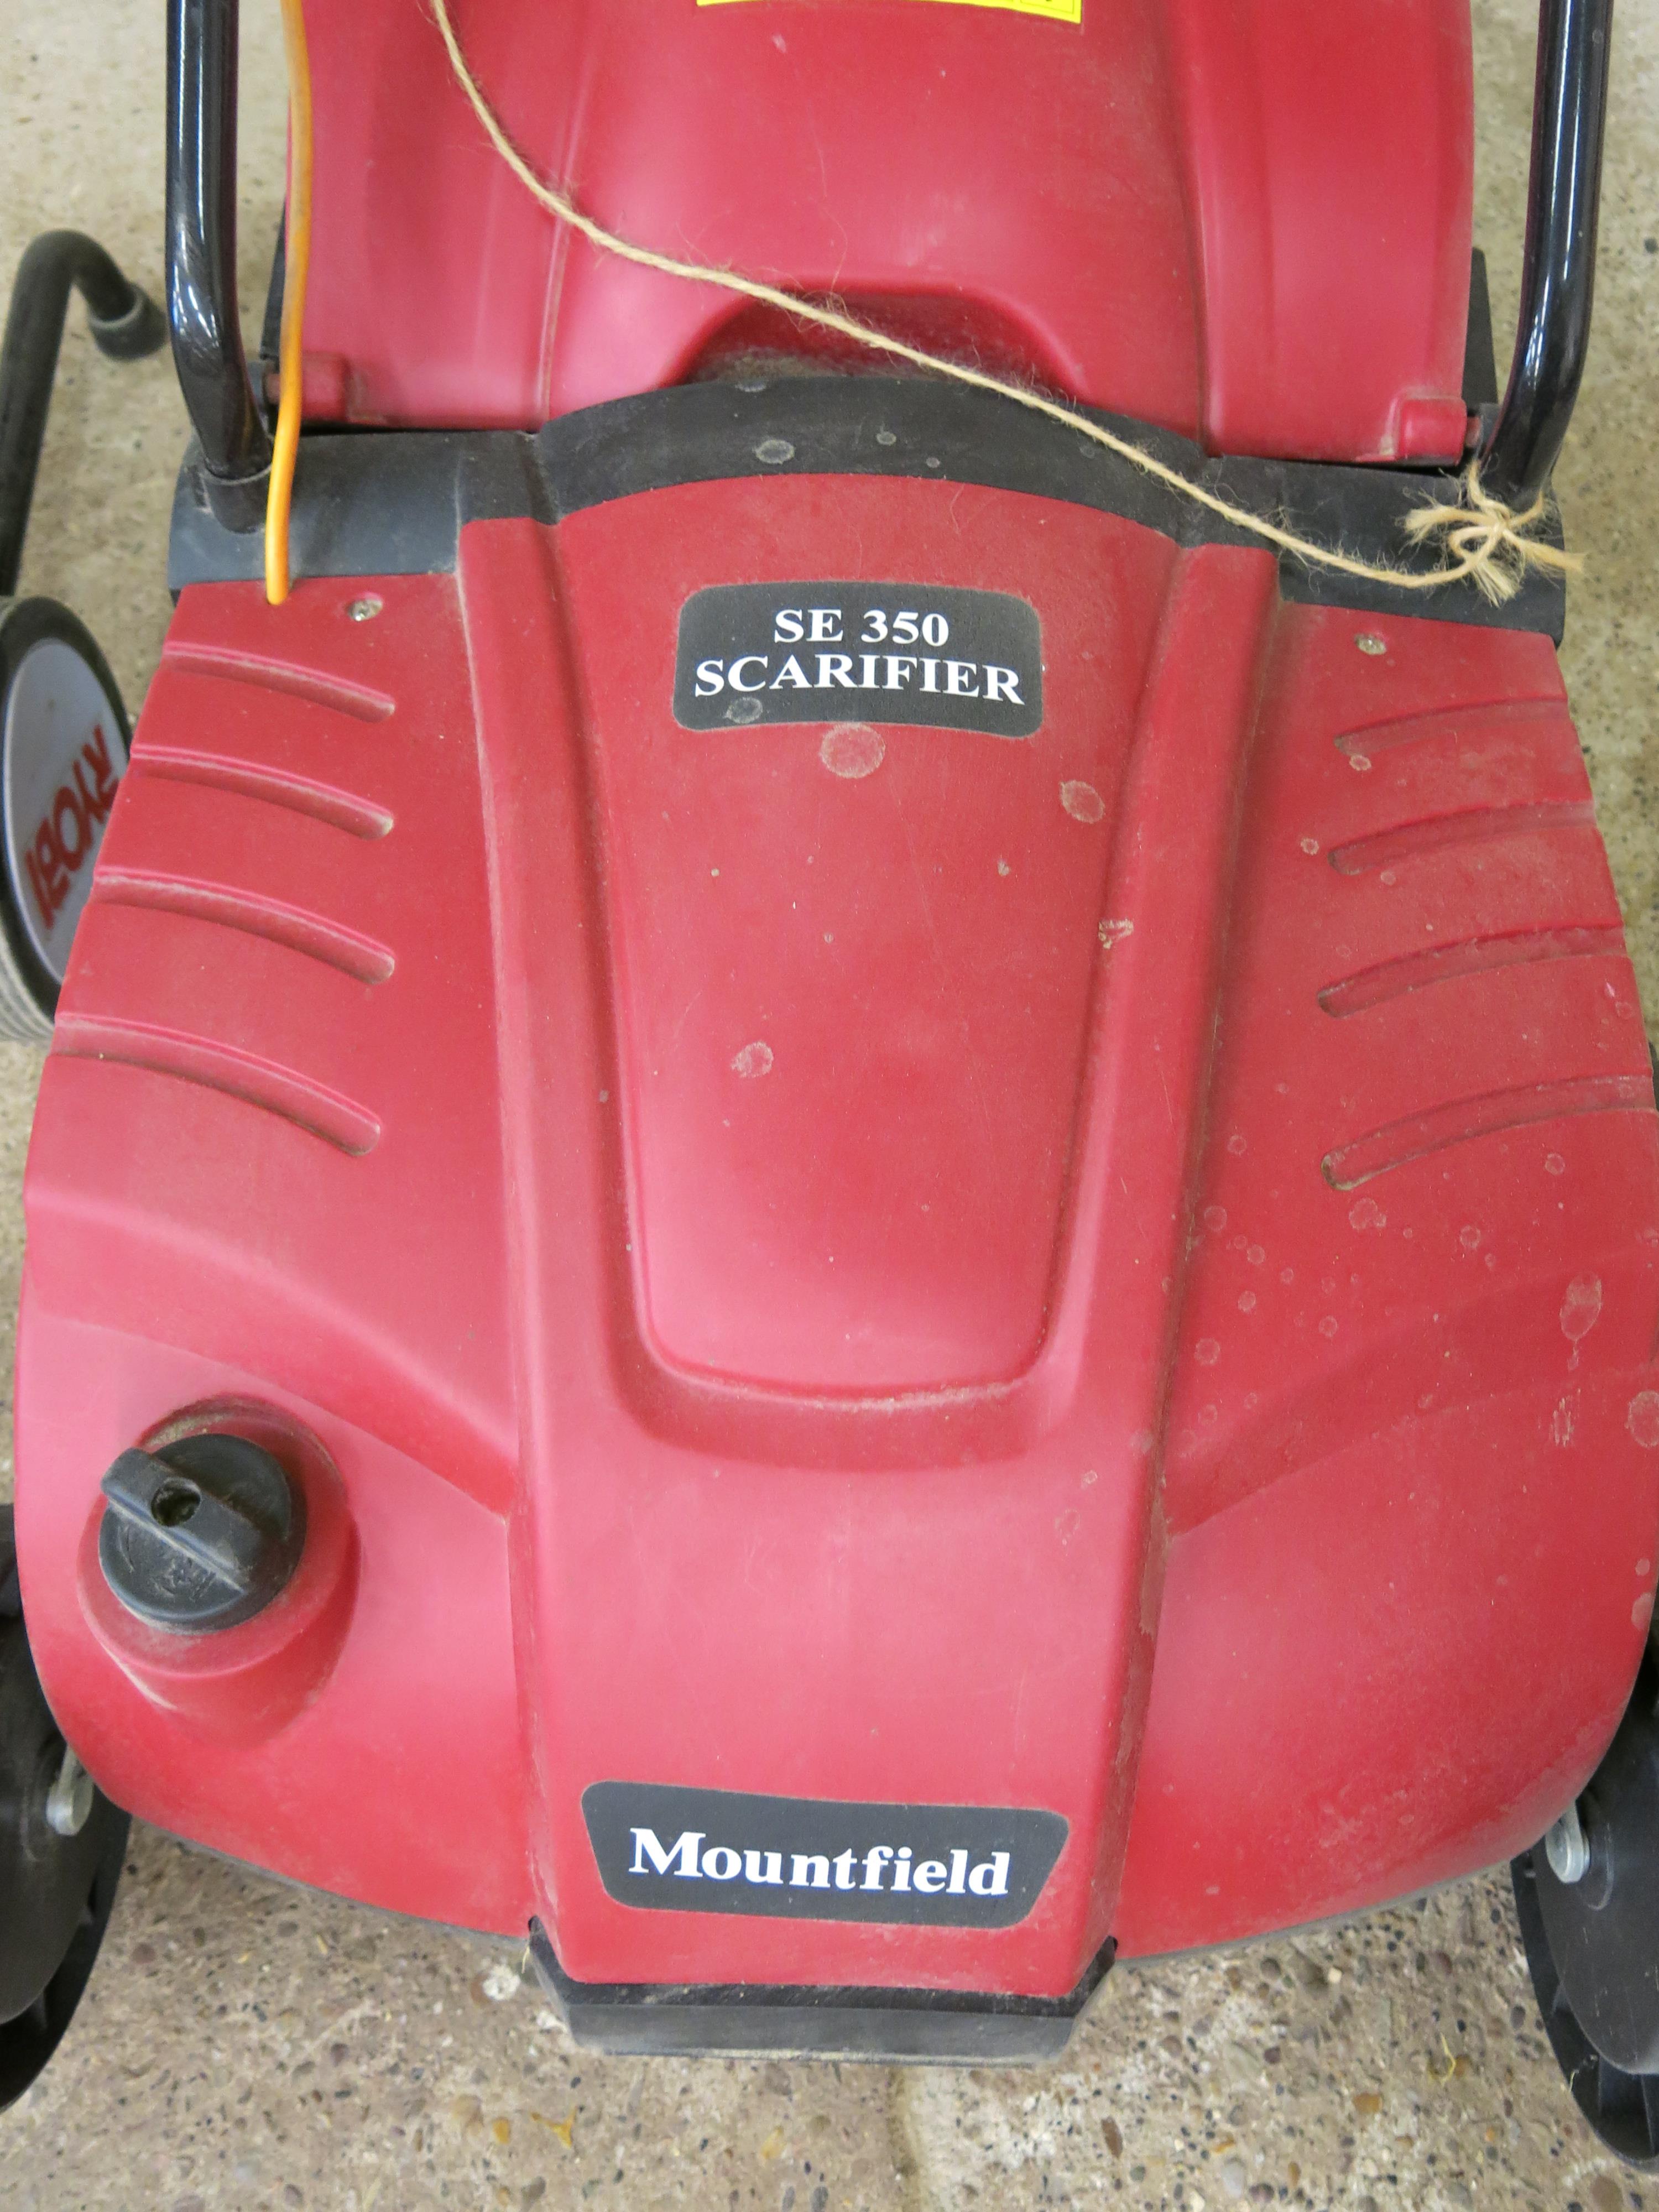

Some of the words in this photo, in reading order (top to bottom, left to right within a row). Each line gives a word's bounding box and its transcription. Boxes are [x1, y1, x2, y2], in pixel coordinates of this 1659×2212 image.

[774, 608, 844, 643] SE
[860, 609, 950, 647] 350
[694, 654, 1026, 706] SCARIFIER
[25, 725, 119, 930] RYOBI
[628, 1827, 1011, 1896] Mountfield
